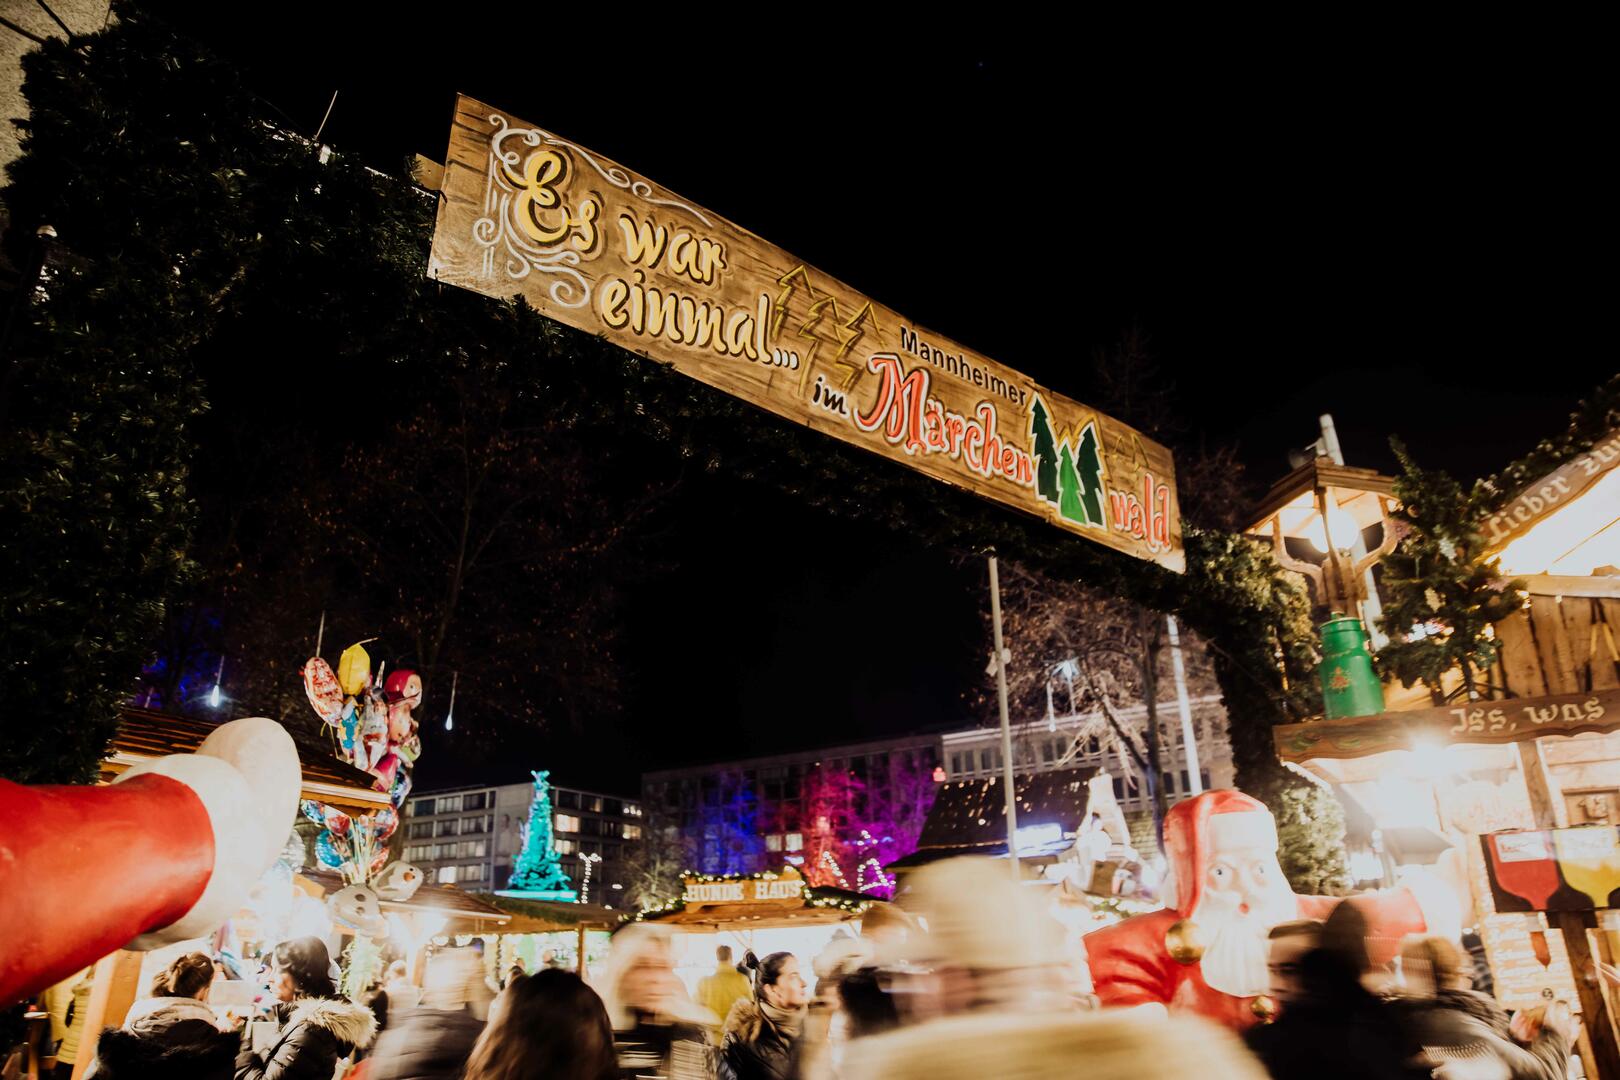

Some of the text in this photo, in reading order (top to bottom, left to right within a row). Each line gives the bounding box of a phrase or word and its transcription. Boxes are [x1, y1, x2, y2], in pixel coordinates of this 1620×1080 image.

[501, 149, 727, 285] Es war
[600, 270, 800, 370] einmal...
[901, 326, 1026, 406] Mannheimer
[813, 353, 1172, 553] im Märchen wald
[1488, 475, 1570, 545] Lieber
